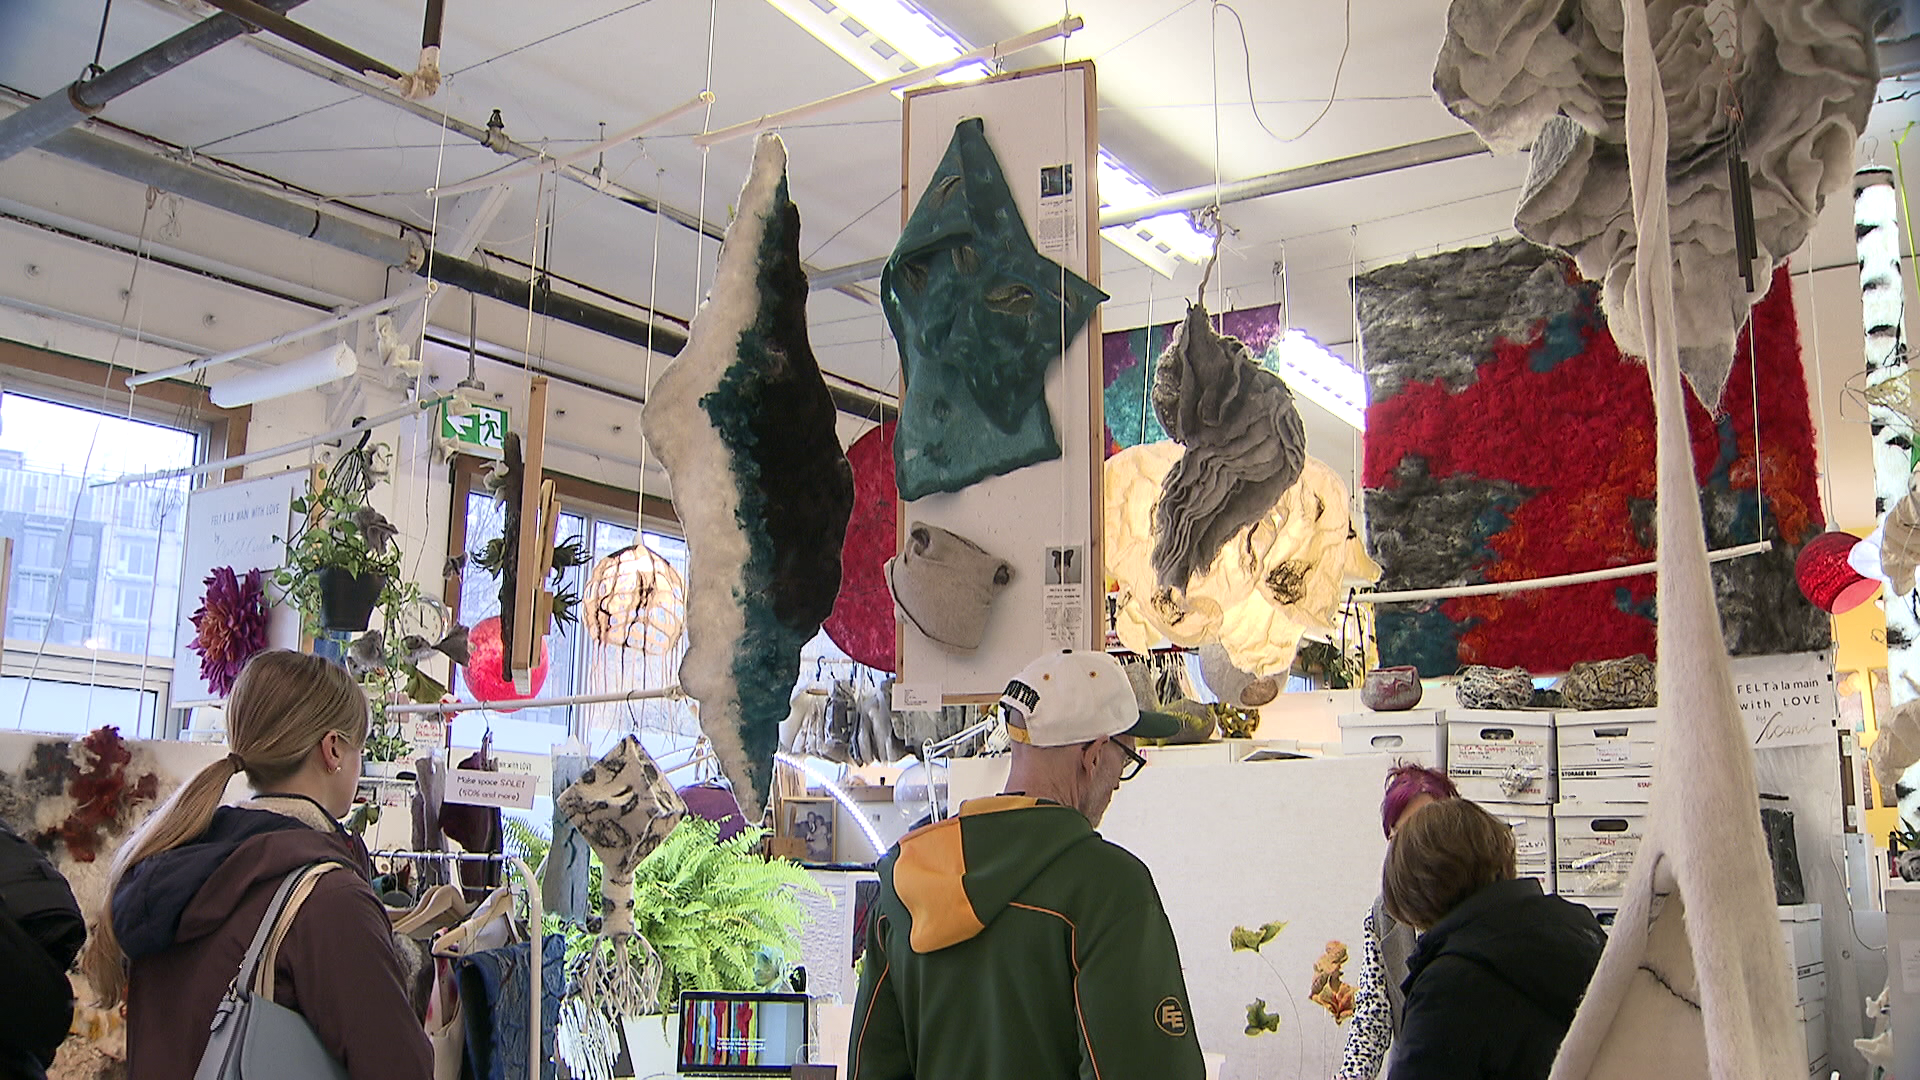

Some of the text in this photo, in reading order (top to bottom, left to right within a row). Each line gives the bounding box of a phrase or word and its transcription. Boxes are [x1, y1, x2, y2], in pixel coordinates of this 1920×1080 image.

[265, 502, 280, 515] LOVE
[1737, 682, 1769, 694] FELT
[1781, 680, 1791, 691] la
[1793, 678, 1819, 689] main
[1740, 695, 1820, 710] with LOVE
[457, 775, 526, 789] Make space SALE!
[458, 787, 520, 802] (50% and more)
